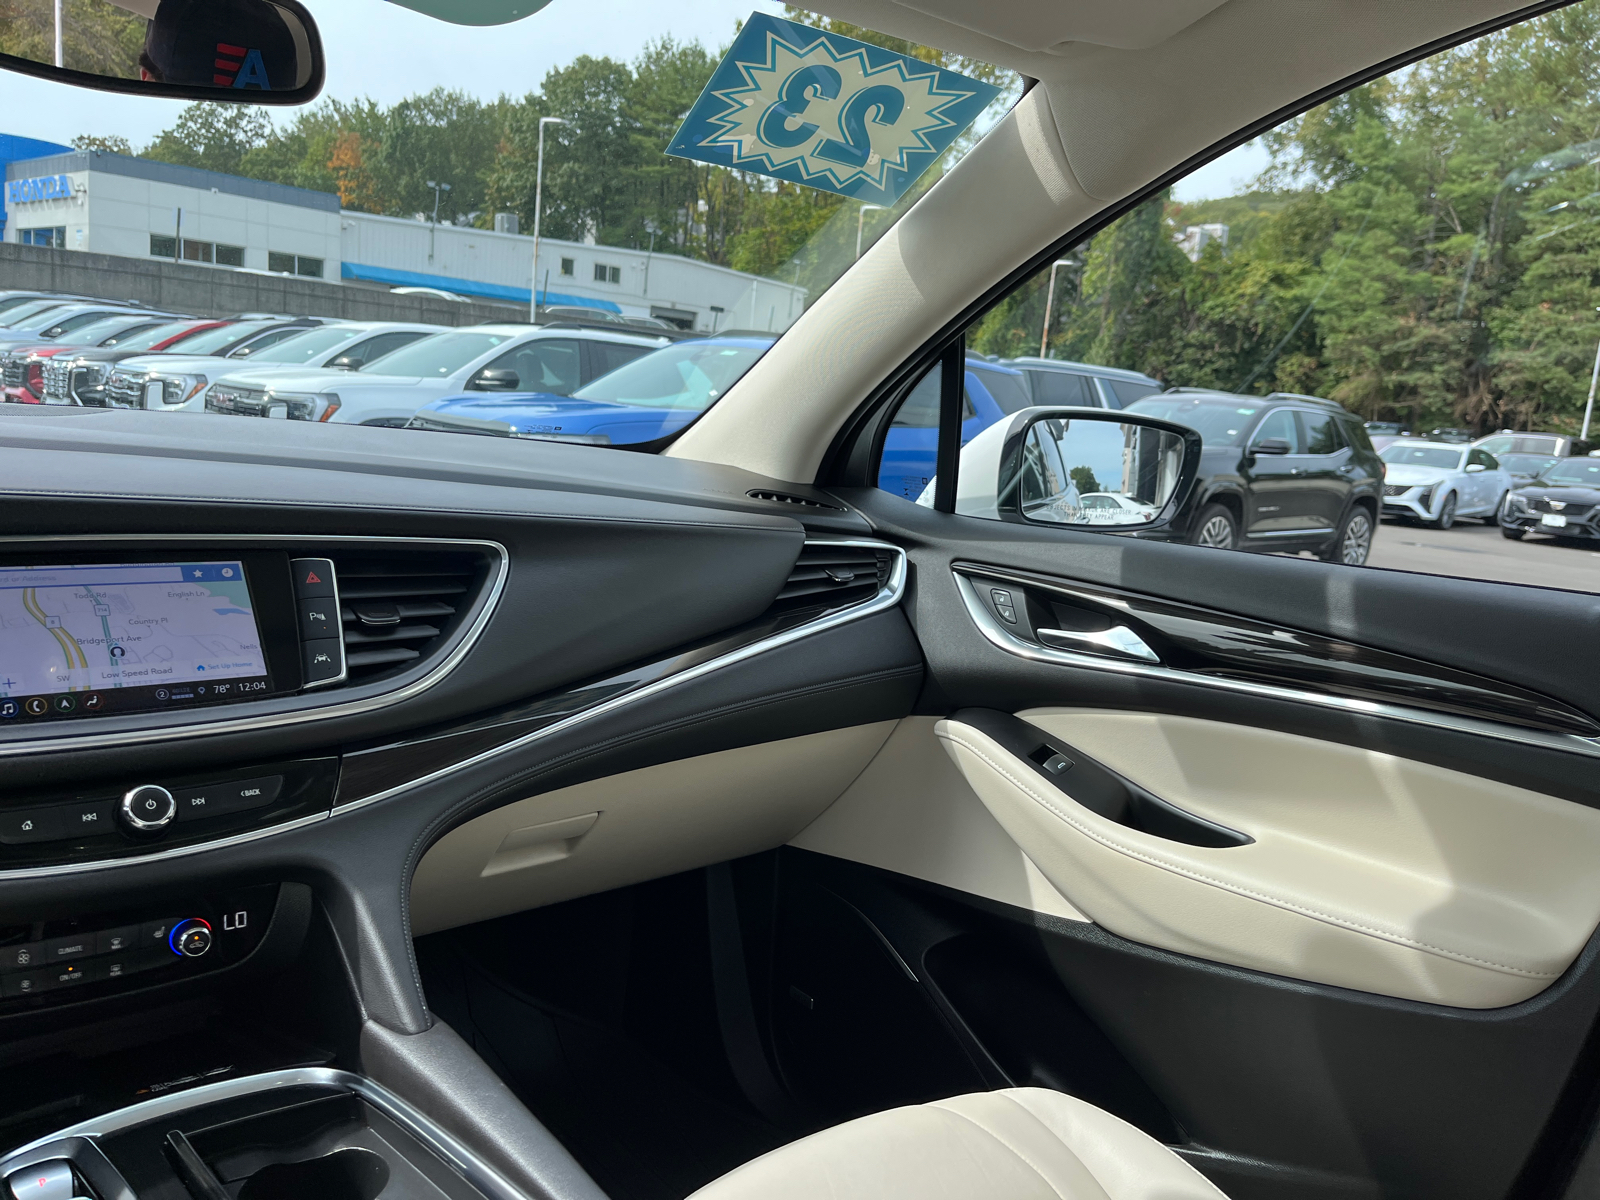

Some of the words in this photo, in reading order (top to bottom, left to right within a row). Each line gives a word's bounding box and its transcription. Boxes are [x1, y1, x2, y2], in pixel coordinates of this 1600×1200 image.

[8, 174, 71, 203] HONDA
[76, 636, 125, 645] Bridgeport
[122, 669, 149, 678] Speed
[151, 667, 173, 675] Road
[238, 681, 266, 691] 12:04
[223, 910, 247, 930] LO
[58, 945, 83, 955] CLIMATE
